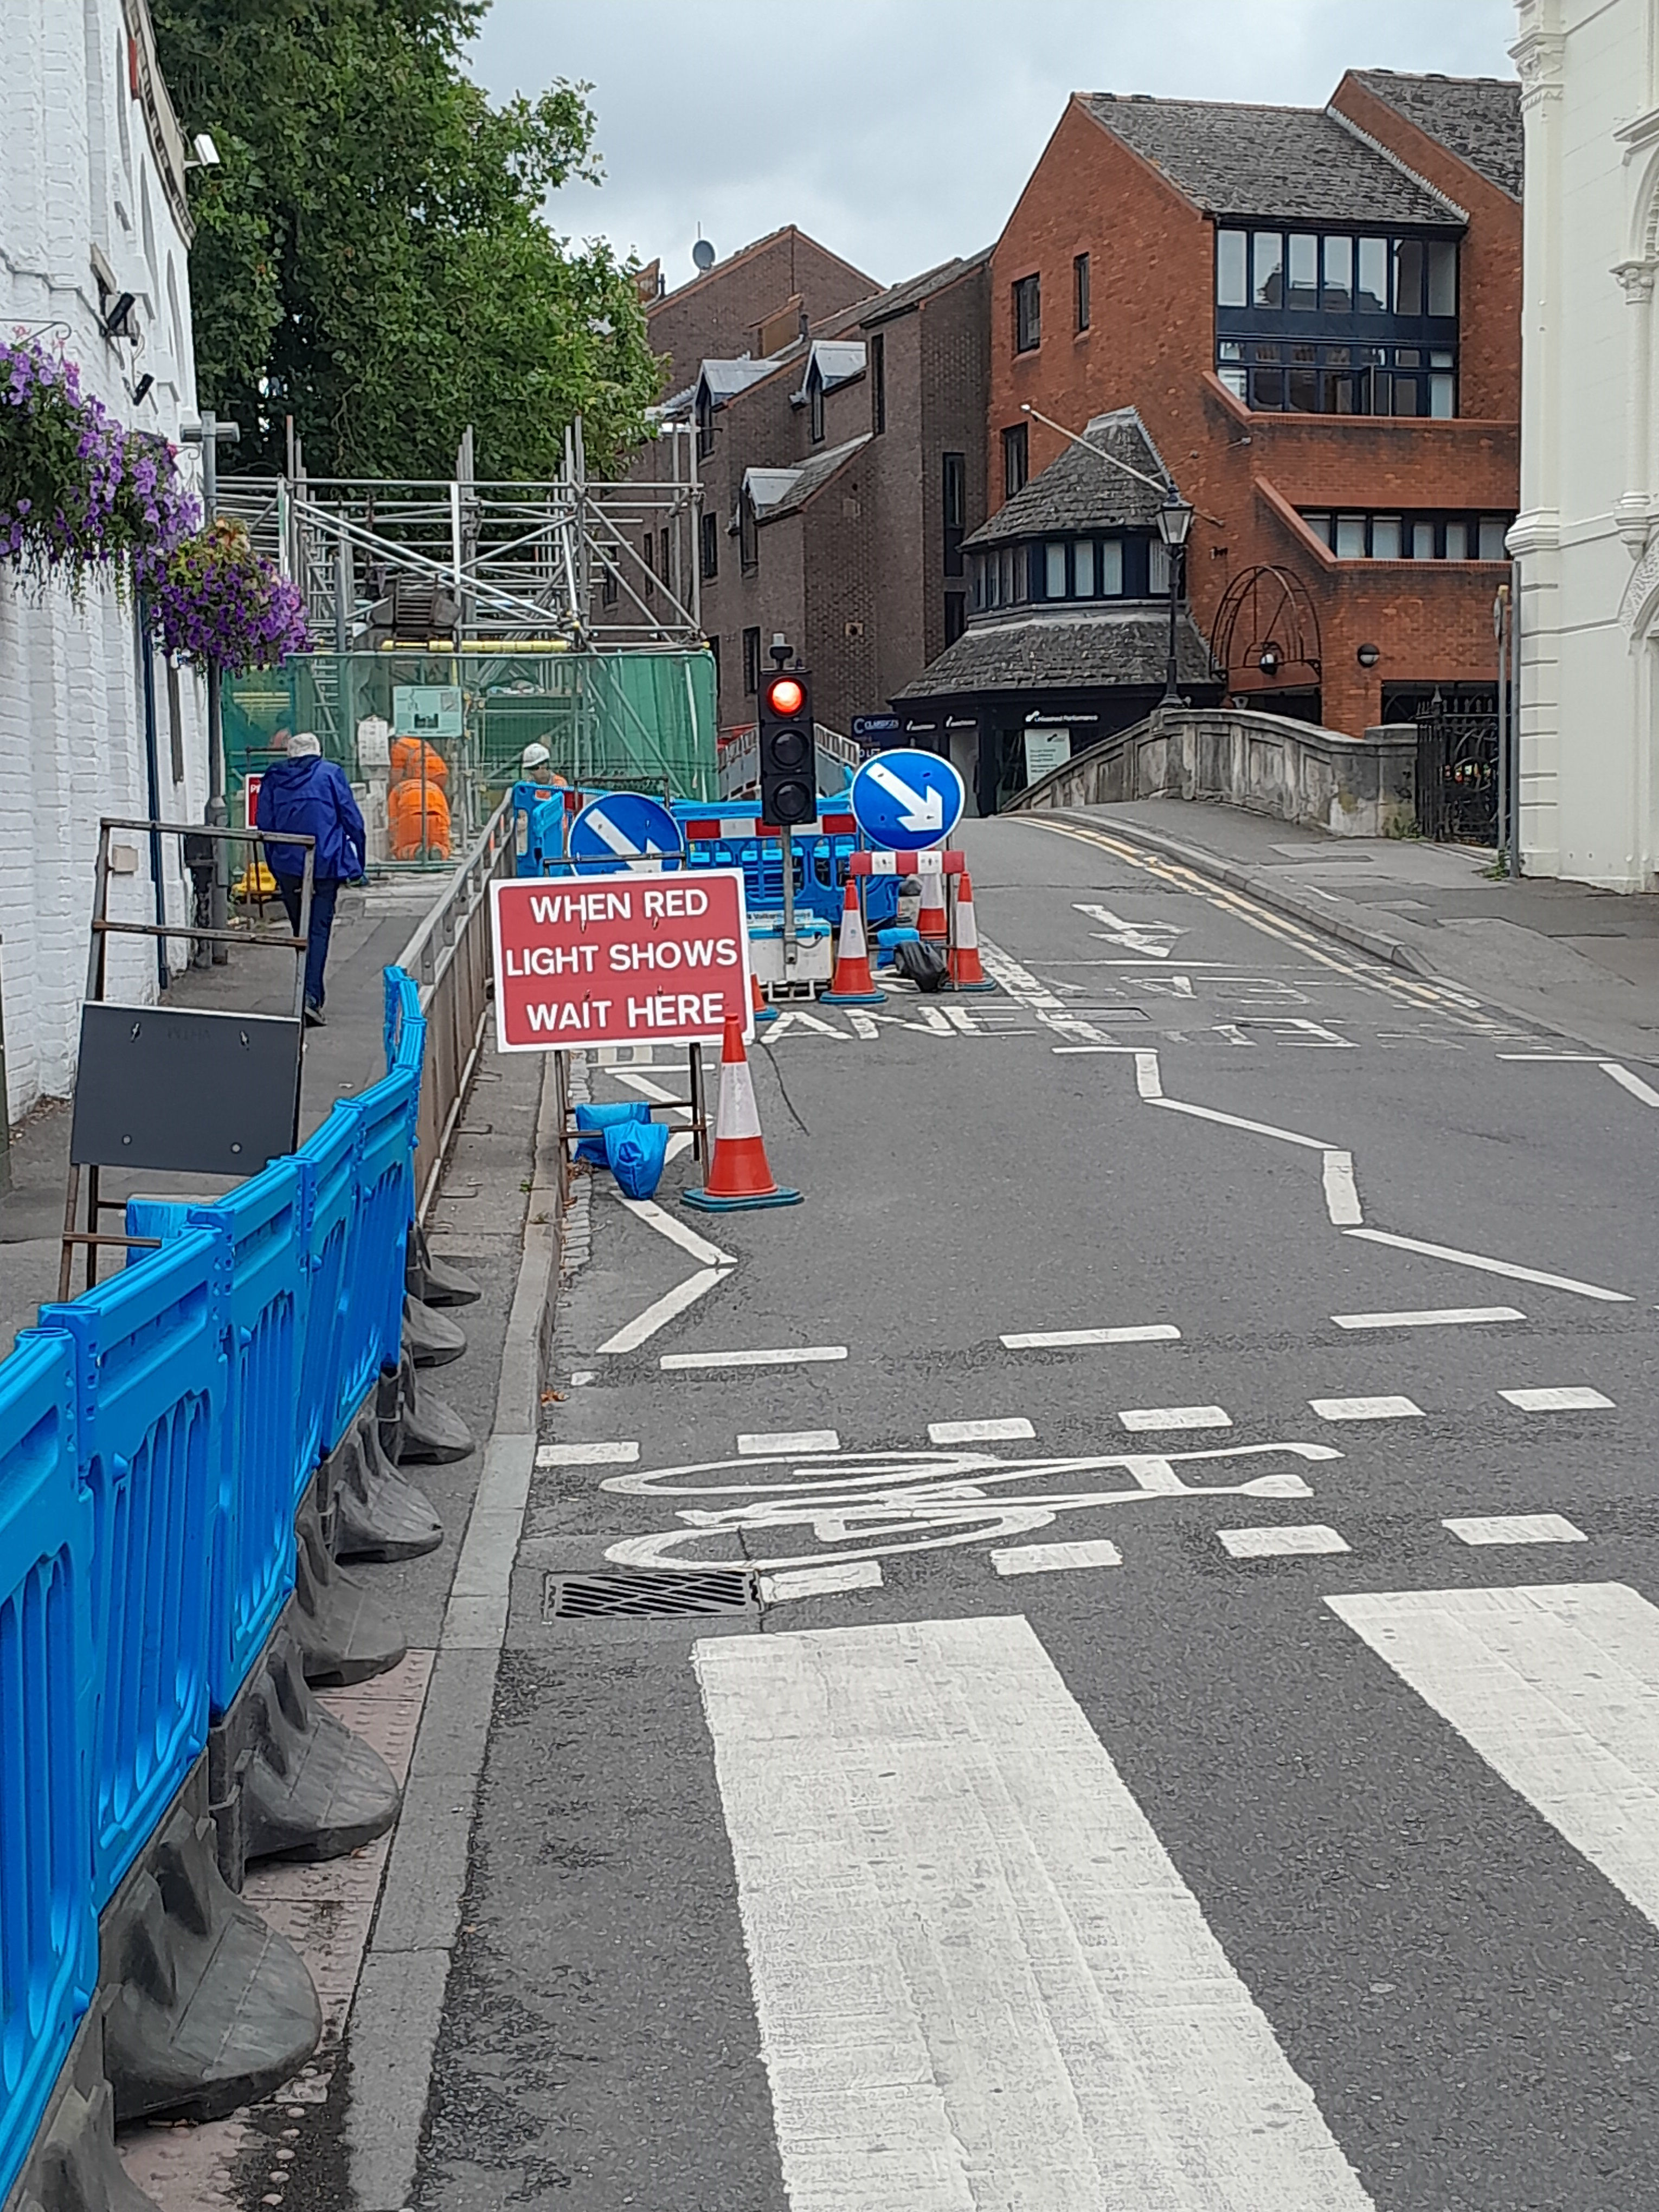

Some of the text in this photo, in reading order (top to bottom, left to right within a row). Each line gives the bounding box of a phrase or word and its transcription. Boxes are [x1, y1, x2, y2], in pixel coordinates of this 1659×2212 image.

[530, 889, 709, 923] WHEN RED
[506, 939, 738, 976] LIGHT SHOWS
[526, 993, 726, 1031] WAIT HERE
